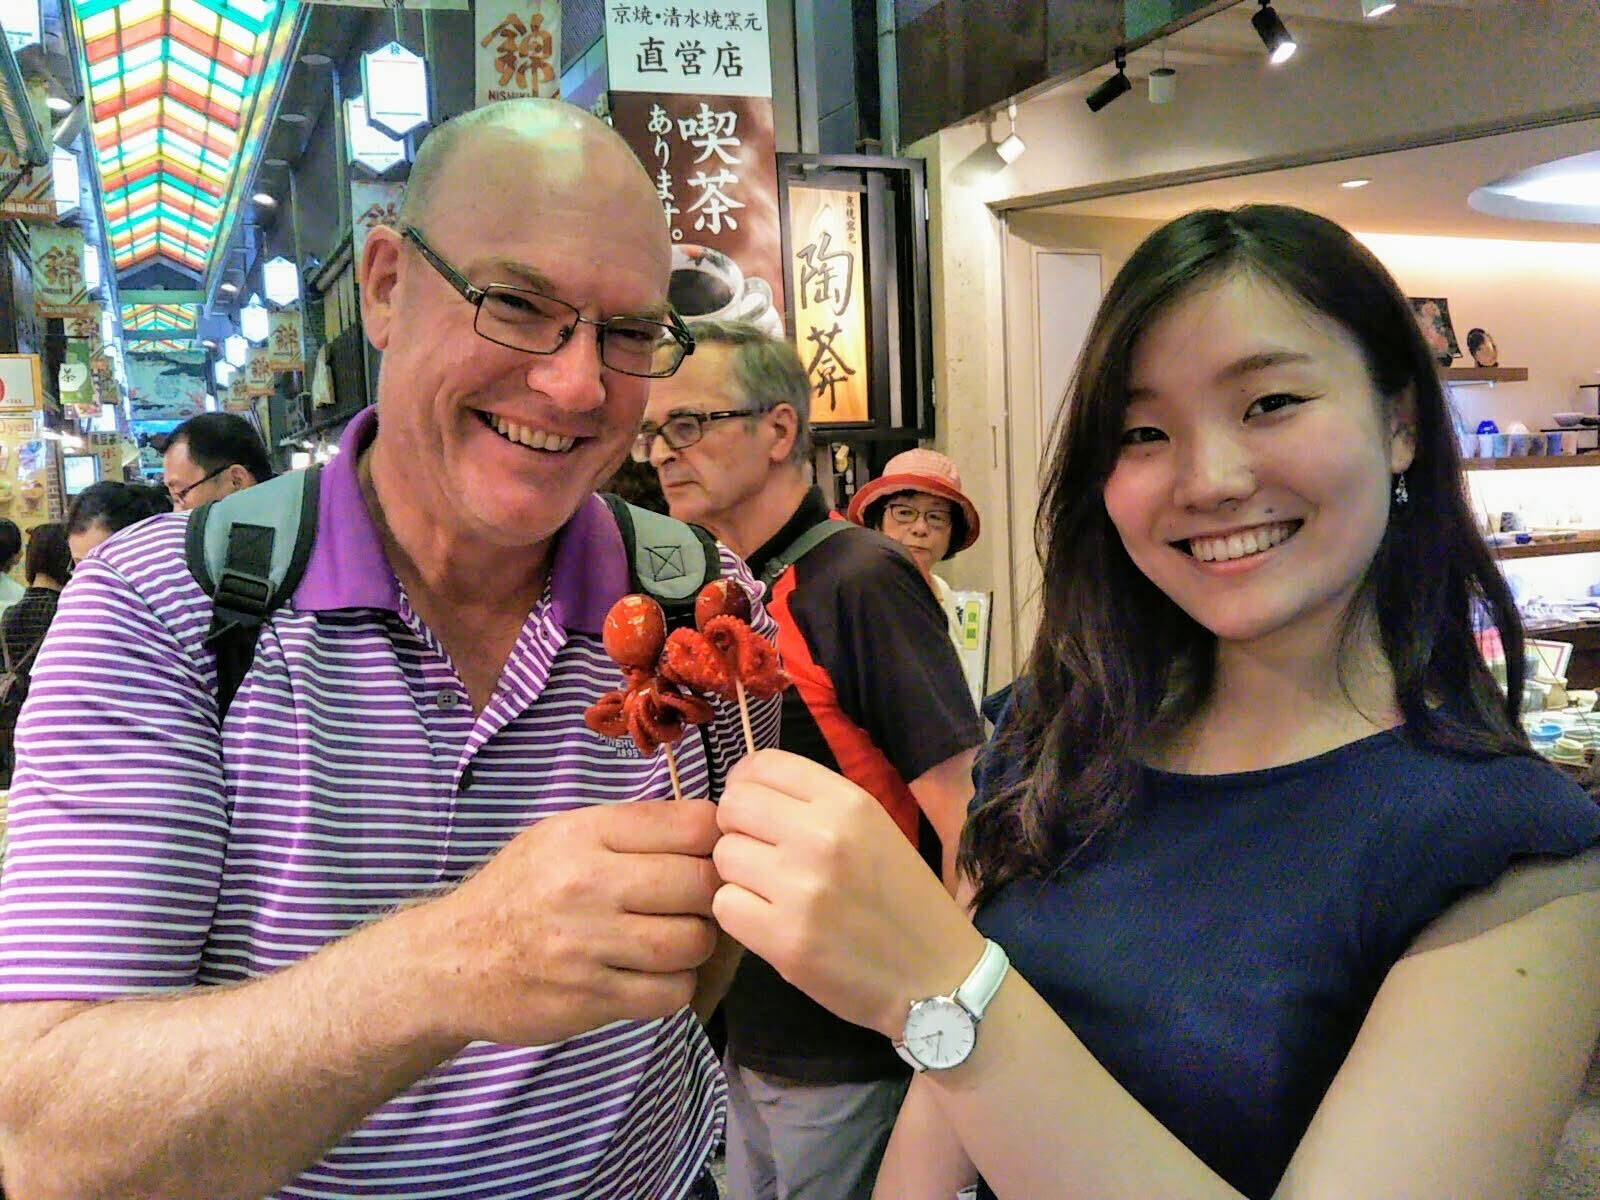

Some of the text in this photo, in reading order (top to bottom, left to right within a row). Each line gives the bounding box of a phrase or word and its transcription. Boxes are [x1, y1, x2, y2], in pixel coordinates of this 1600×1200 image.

[611, 4, 763, 31] 京焼・清水焼窯元
[636, 36, 744, 78] 直営店
[677, 102, 746, 235] 喫茶
